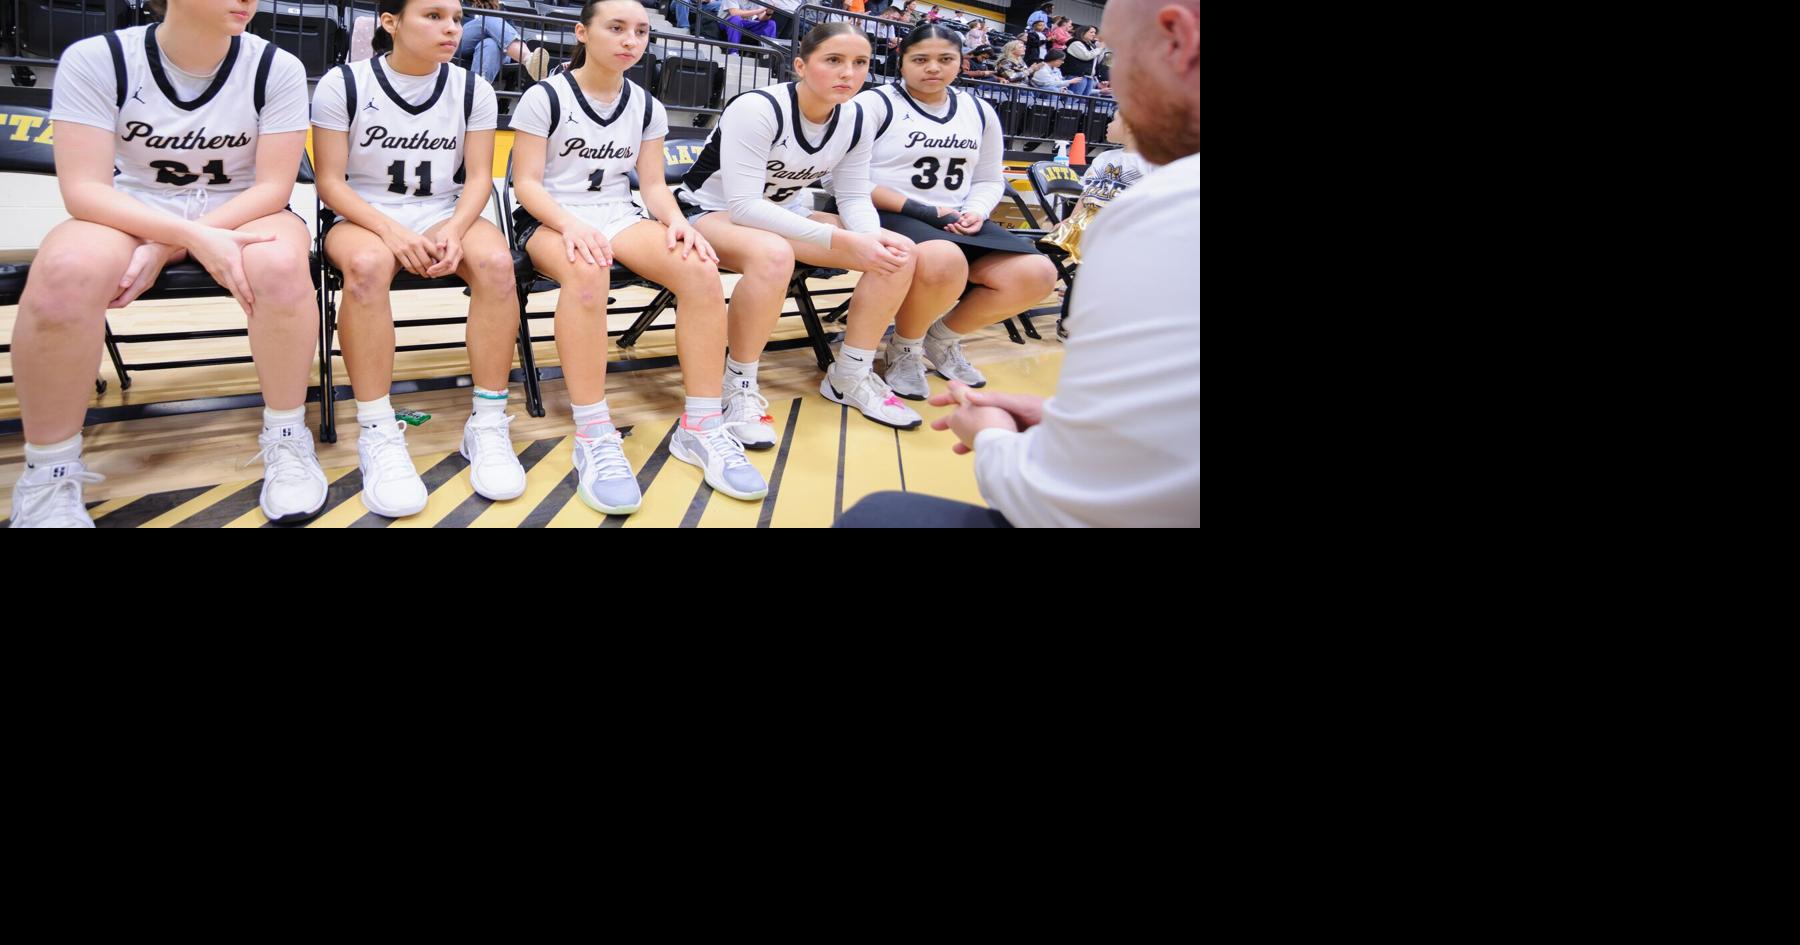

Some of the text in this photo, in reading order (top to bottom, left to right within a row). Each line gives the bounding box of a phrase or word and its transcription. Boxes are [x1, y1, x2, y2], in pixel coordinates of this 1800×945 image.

[121, 121, 251, 150] Panthers
[360, 125, 457, 150] Panthers
[905, 131, 978, 150] Panthers
[149, 159, 232, 187] 21
[386, 160, 433, 197] 11
[586, 168, 606, 192] 1
[911, 156, 967, 191] 35
[1041, 166, 1081, 183] LATTA
